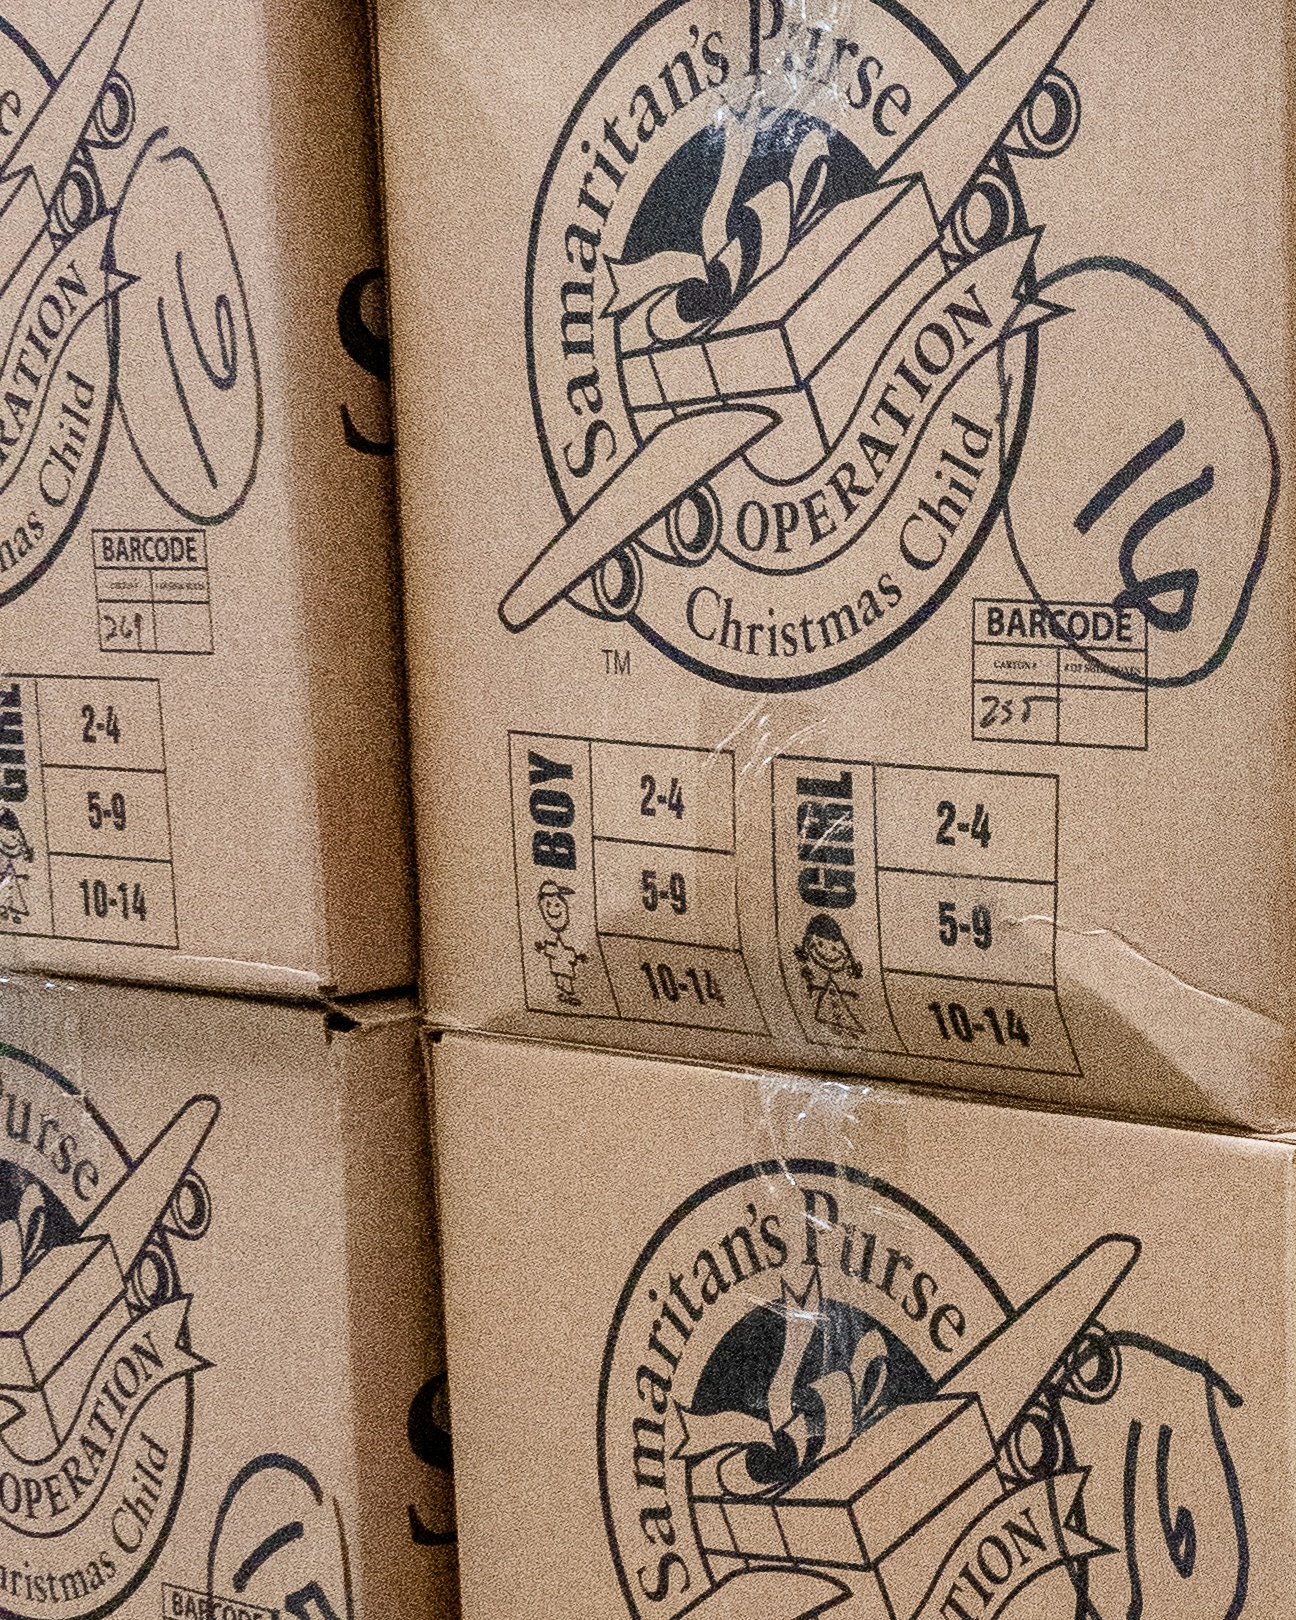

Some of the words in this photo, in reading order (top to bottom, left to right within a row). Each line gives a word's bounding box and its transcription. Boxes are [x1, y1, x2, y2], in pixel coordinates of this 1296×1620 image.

[557, 25, 731, 478] Samaritan's
[38, 369, 96, 509] Child
[736, 284, 994, 553] OPERATION
[102, 536, 198, 563] BARCODE
[685, 575, 903, 658] Christmas
[898, 411, 993, 573] Child
[986, 606, 1133, 642] BARCODE
[81, 705, 120, 744] 2-4
[87, 792, 126, 831] 5-9
[528, 750, 577, 872] BOY
[639, 774, 686, 819] 2-4
[797, 770, 857, 908] GIRL
[935, 800, 991, 848] 2-4
[79, 879, 147, 921] 10-14
[641, 870, 688, 916] 5-9
[938, 900, 992, 950] 5-9
[640, 962, 725, 1008] 10-14
[930, 1001, 1031, 1048] 10-14
[0, 1092, 100, 1202] urse
[632, 1203, 789, 1603] Samaritan's
[802, 1188, 967, 1353] Purse
[111, 1431, 170, 1556] Child
